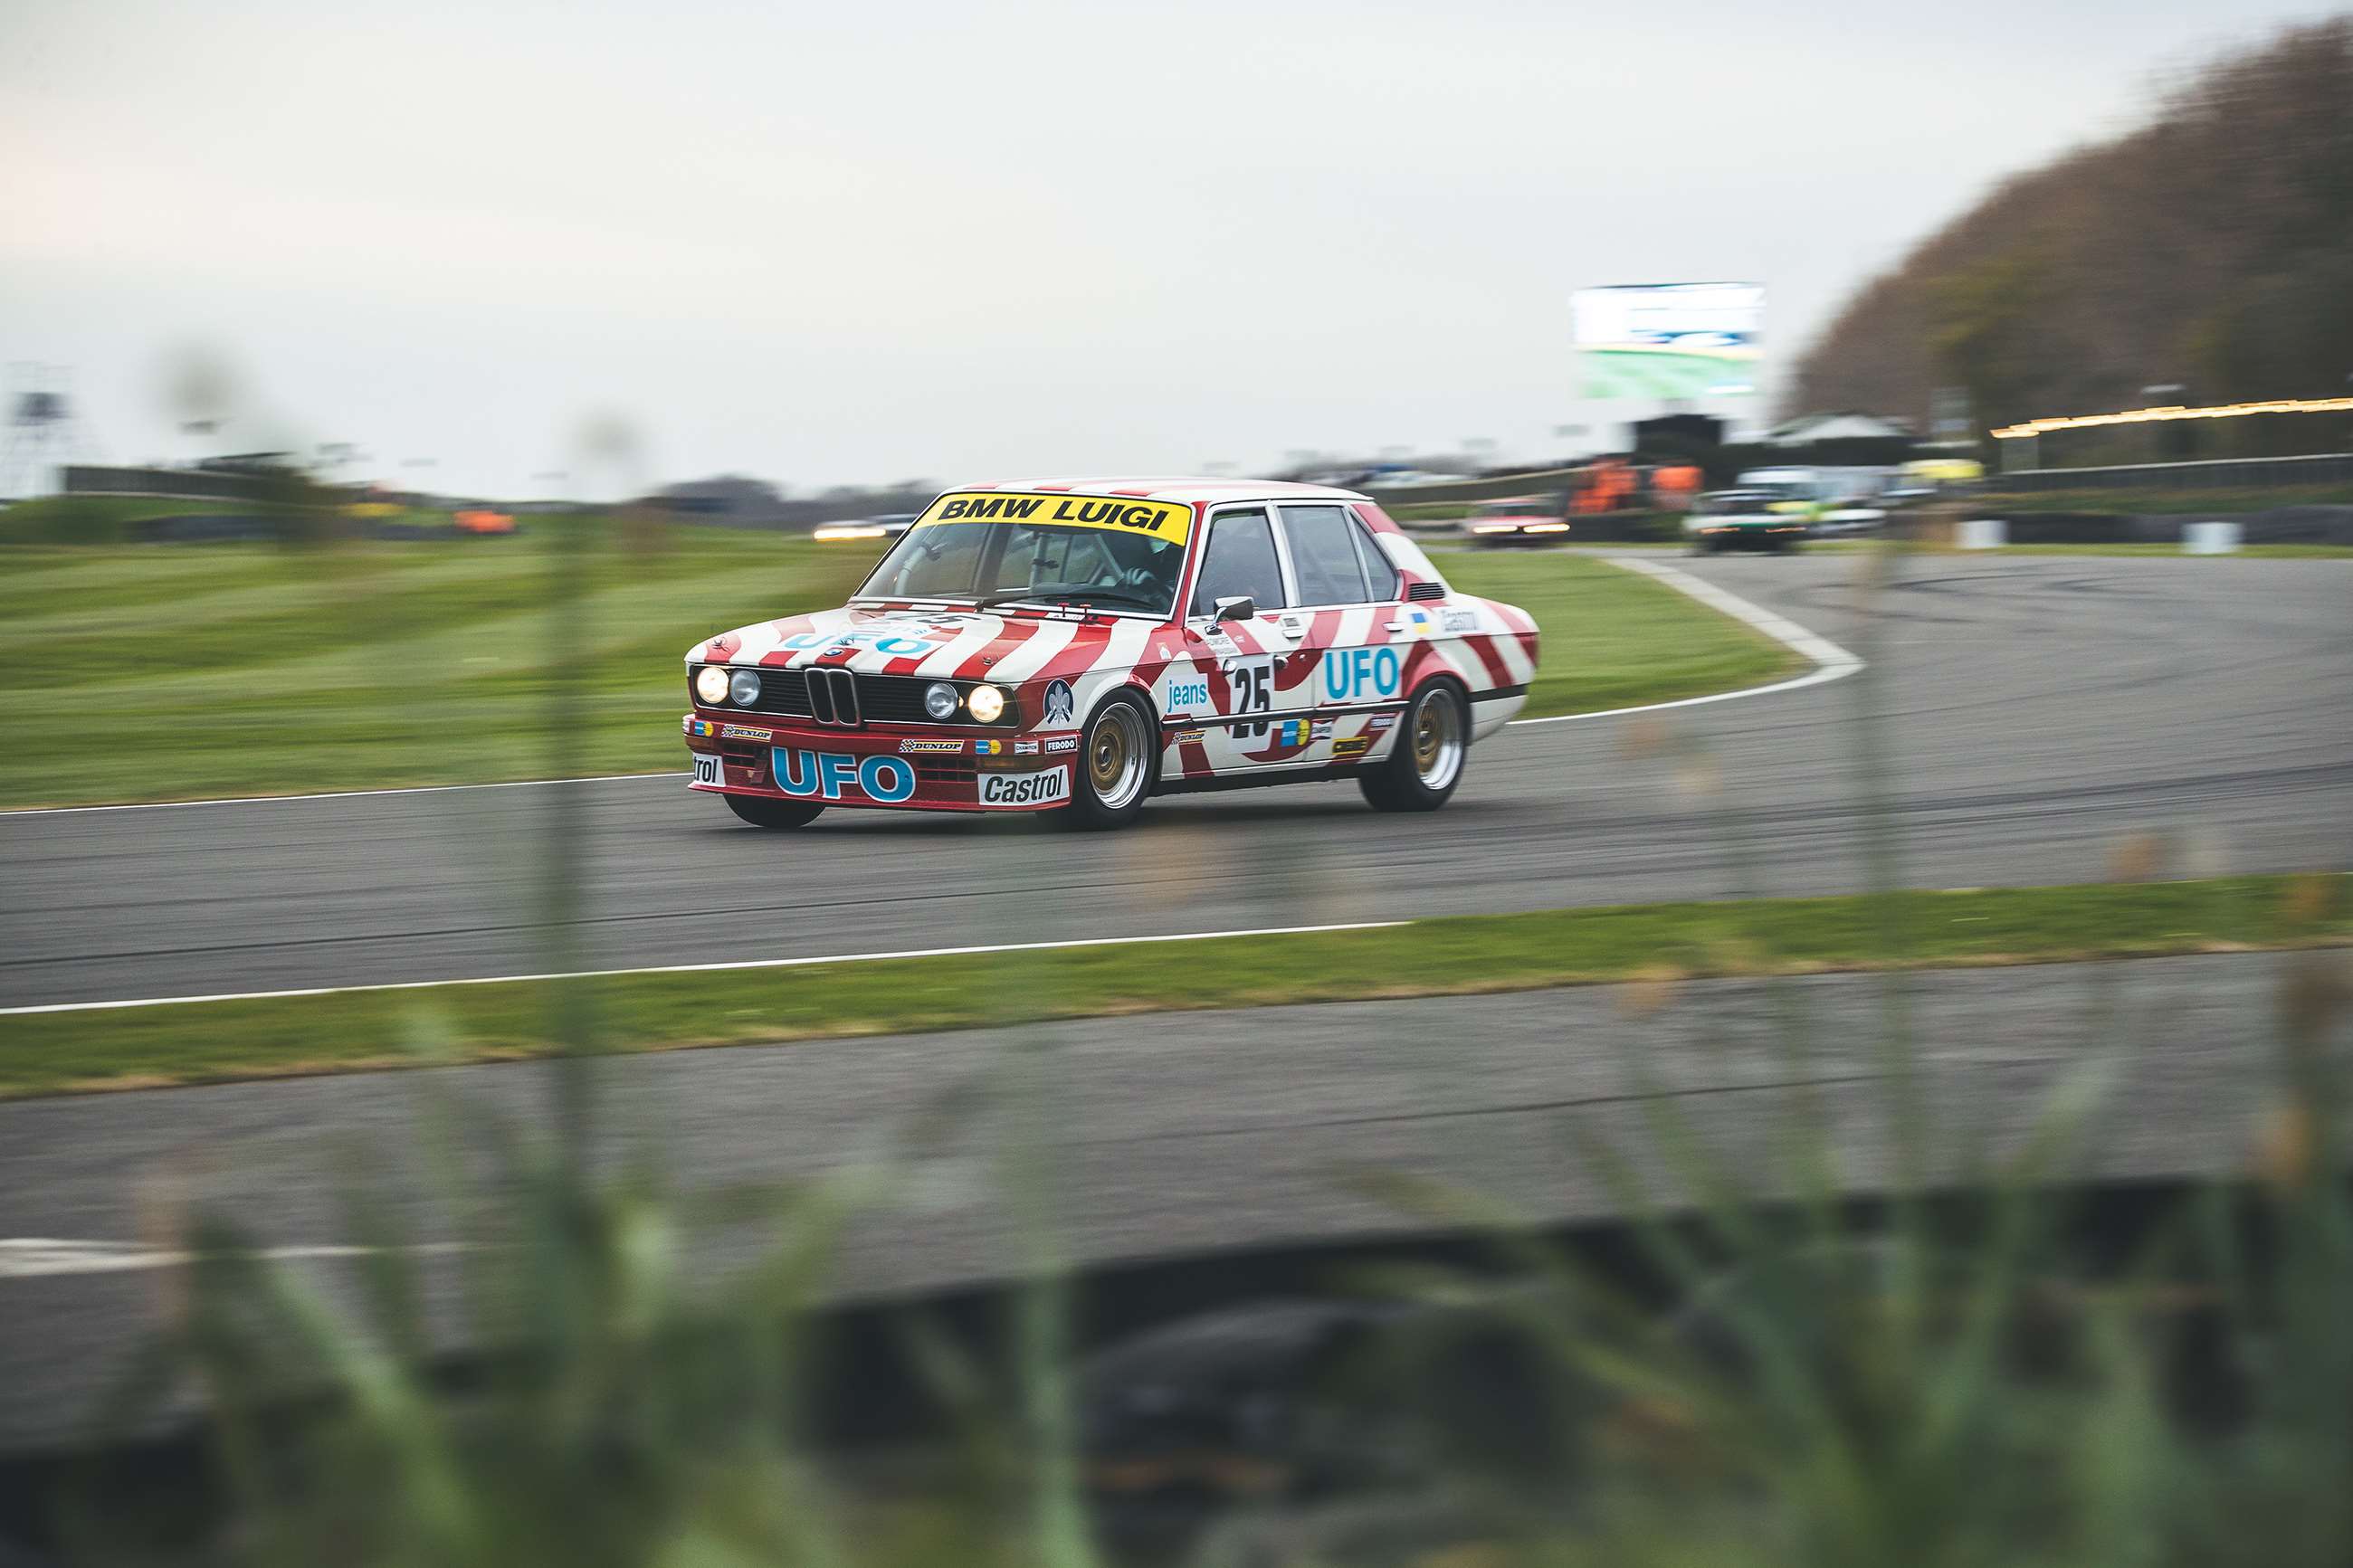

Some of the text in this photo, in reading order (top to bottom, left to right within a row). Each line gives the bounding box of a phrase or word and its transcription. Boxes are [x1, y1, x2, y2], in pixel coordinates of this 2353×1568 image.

[938, 499, 1169, 531] BMW LUIGI
[785, 632, 932, 654] UFO
[1324, 647, 1399, 699] UFO
[1167, 679, 1207, 713] jeans
[1233, 666, 1271, 738] 25
[733, 728, 770, 738] DUNLOP
[914, 742, 962, 750] DUNLOP
[1047, 739, 1075, 752] FERODO
[771, 746, 916, 803] UFO
[984, 769, 1063, 803] Castrol
